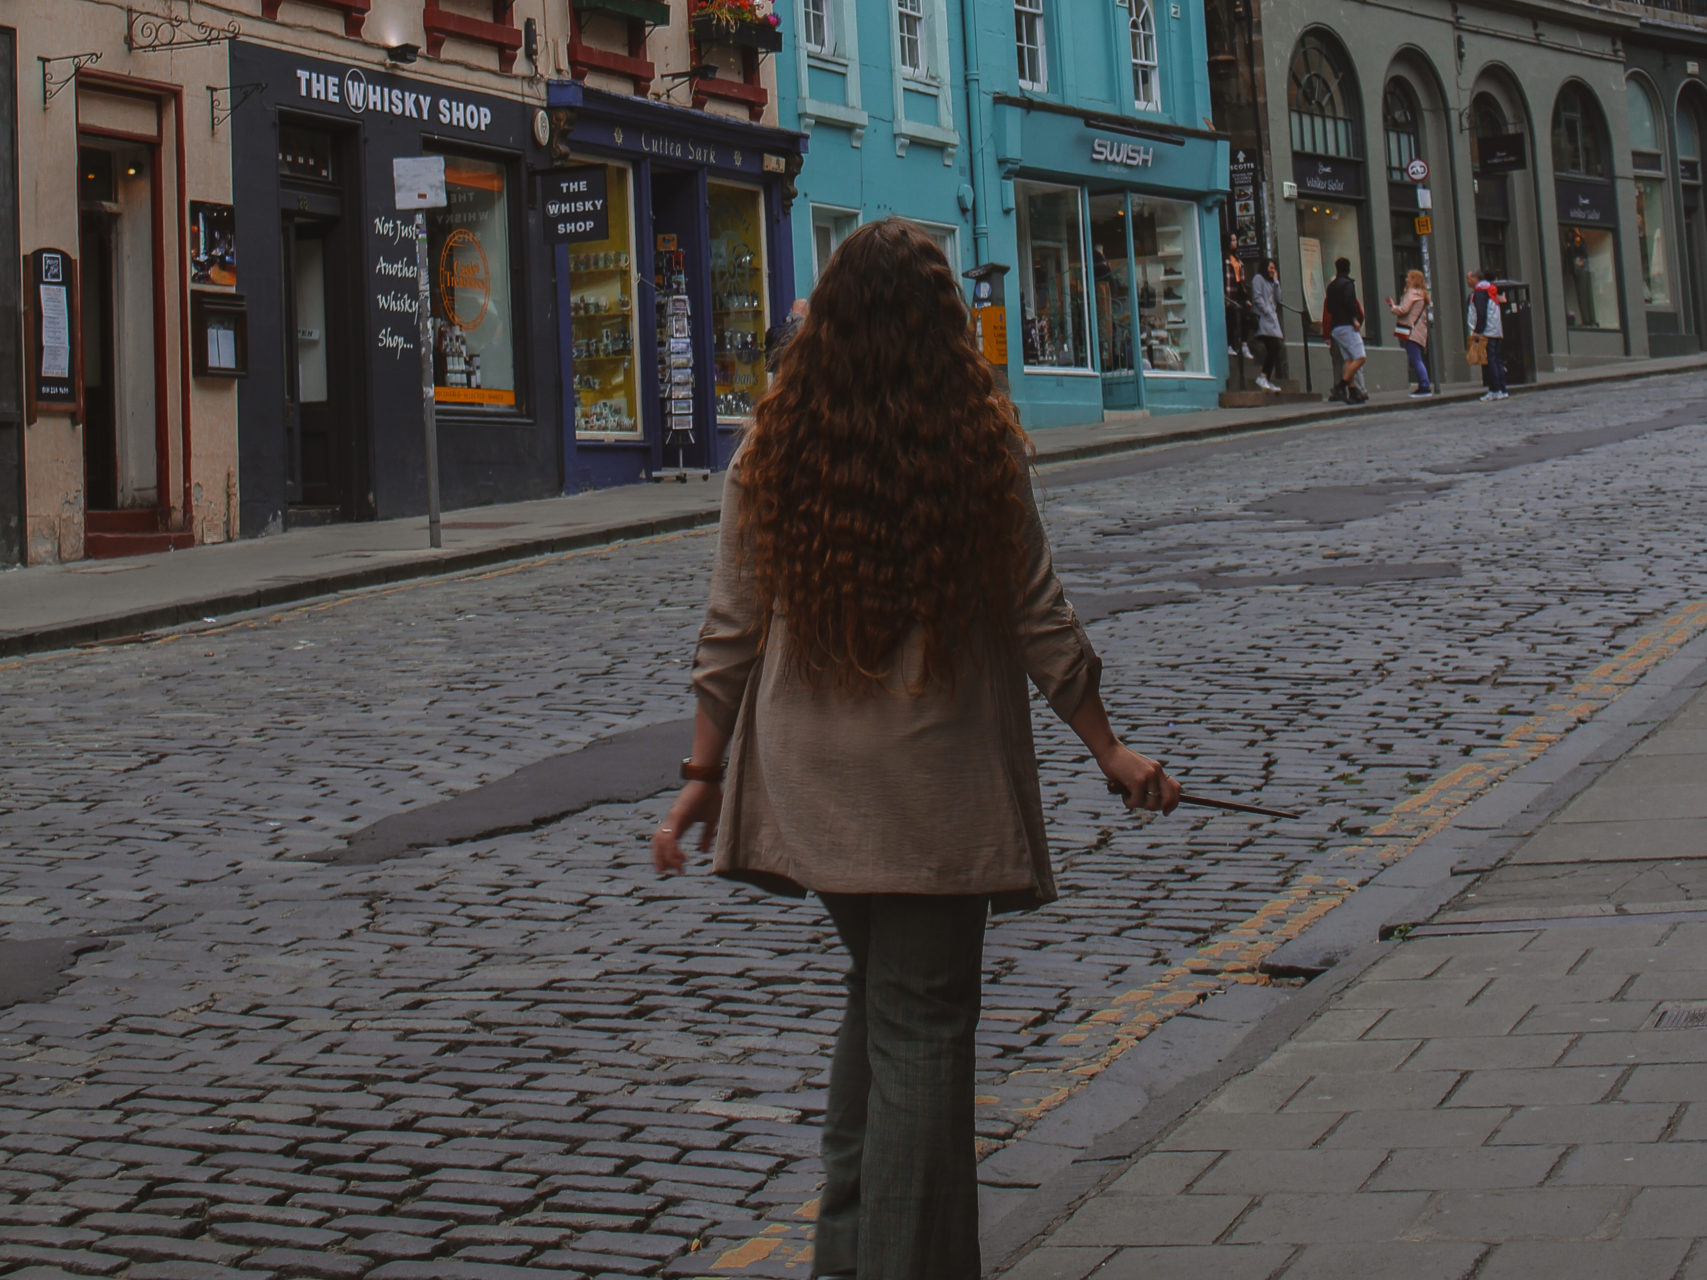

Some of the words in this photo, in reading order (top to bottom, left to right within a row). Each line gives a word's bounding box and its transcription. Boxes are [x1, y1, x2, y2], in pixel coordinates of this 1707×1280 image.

[296, 69, 340, 103] THE
[345, 72, 432, 121] WHISKY
[438, 98, 492, 131] SHOP
[688, 139, 716, 164] Sark
[1092, 138, 1153, 168] SWISH
[560, 180, 588, 194] THE
[547, 200, 603, 216] WHISKY
[374, 216, 394, 237] Not
[394, 219, 419, 246] Just
[557, 220, 595, 234] SHOP
[377, 291, 419, 325] Whisky
[378, 327, 414, 360] Shop...
